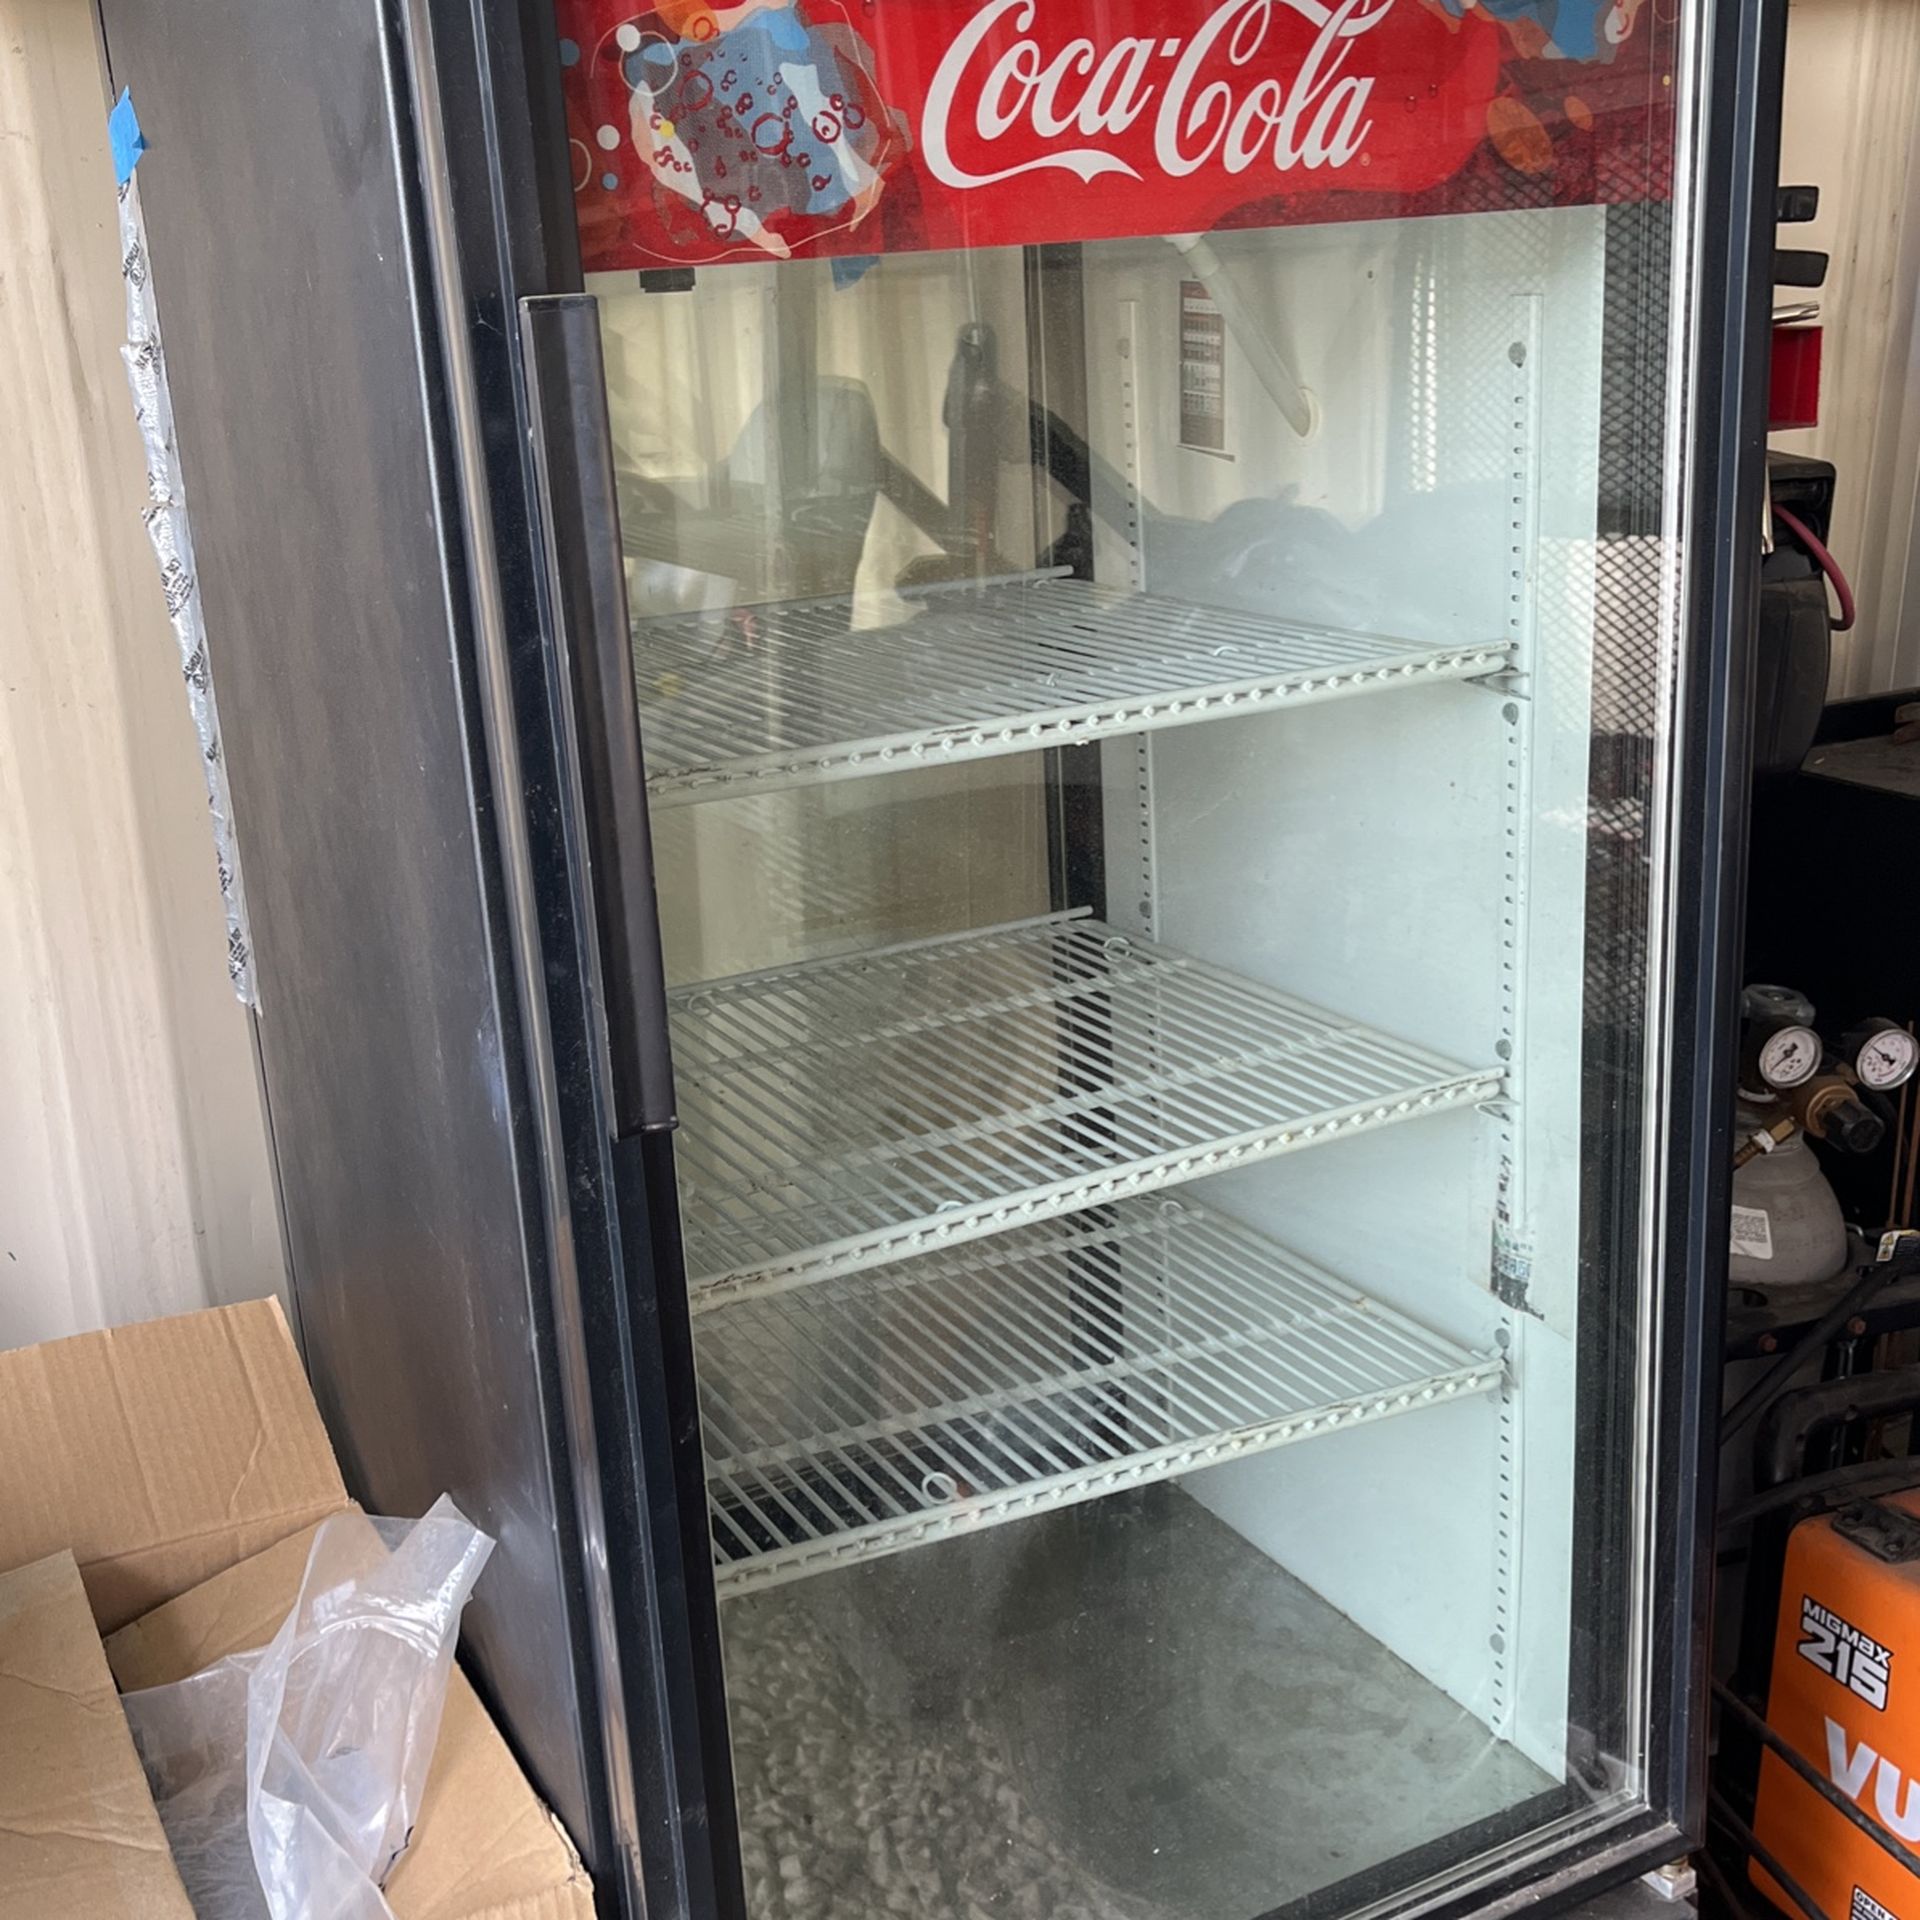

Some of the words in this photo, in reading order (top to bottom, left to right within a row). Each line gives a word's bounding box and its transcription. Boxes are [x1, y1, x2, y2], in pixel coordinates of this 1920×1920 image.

[921, 0, 1394, 189] Coca-Cola
[1798, 1615, 1889, 1711] 215
[1824, 1714, 1920, 1842] VU
